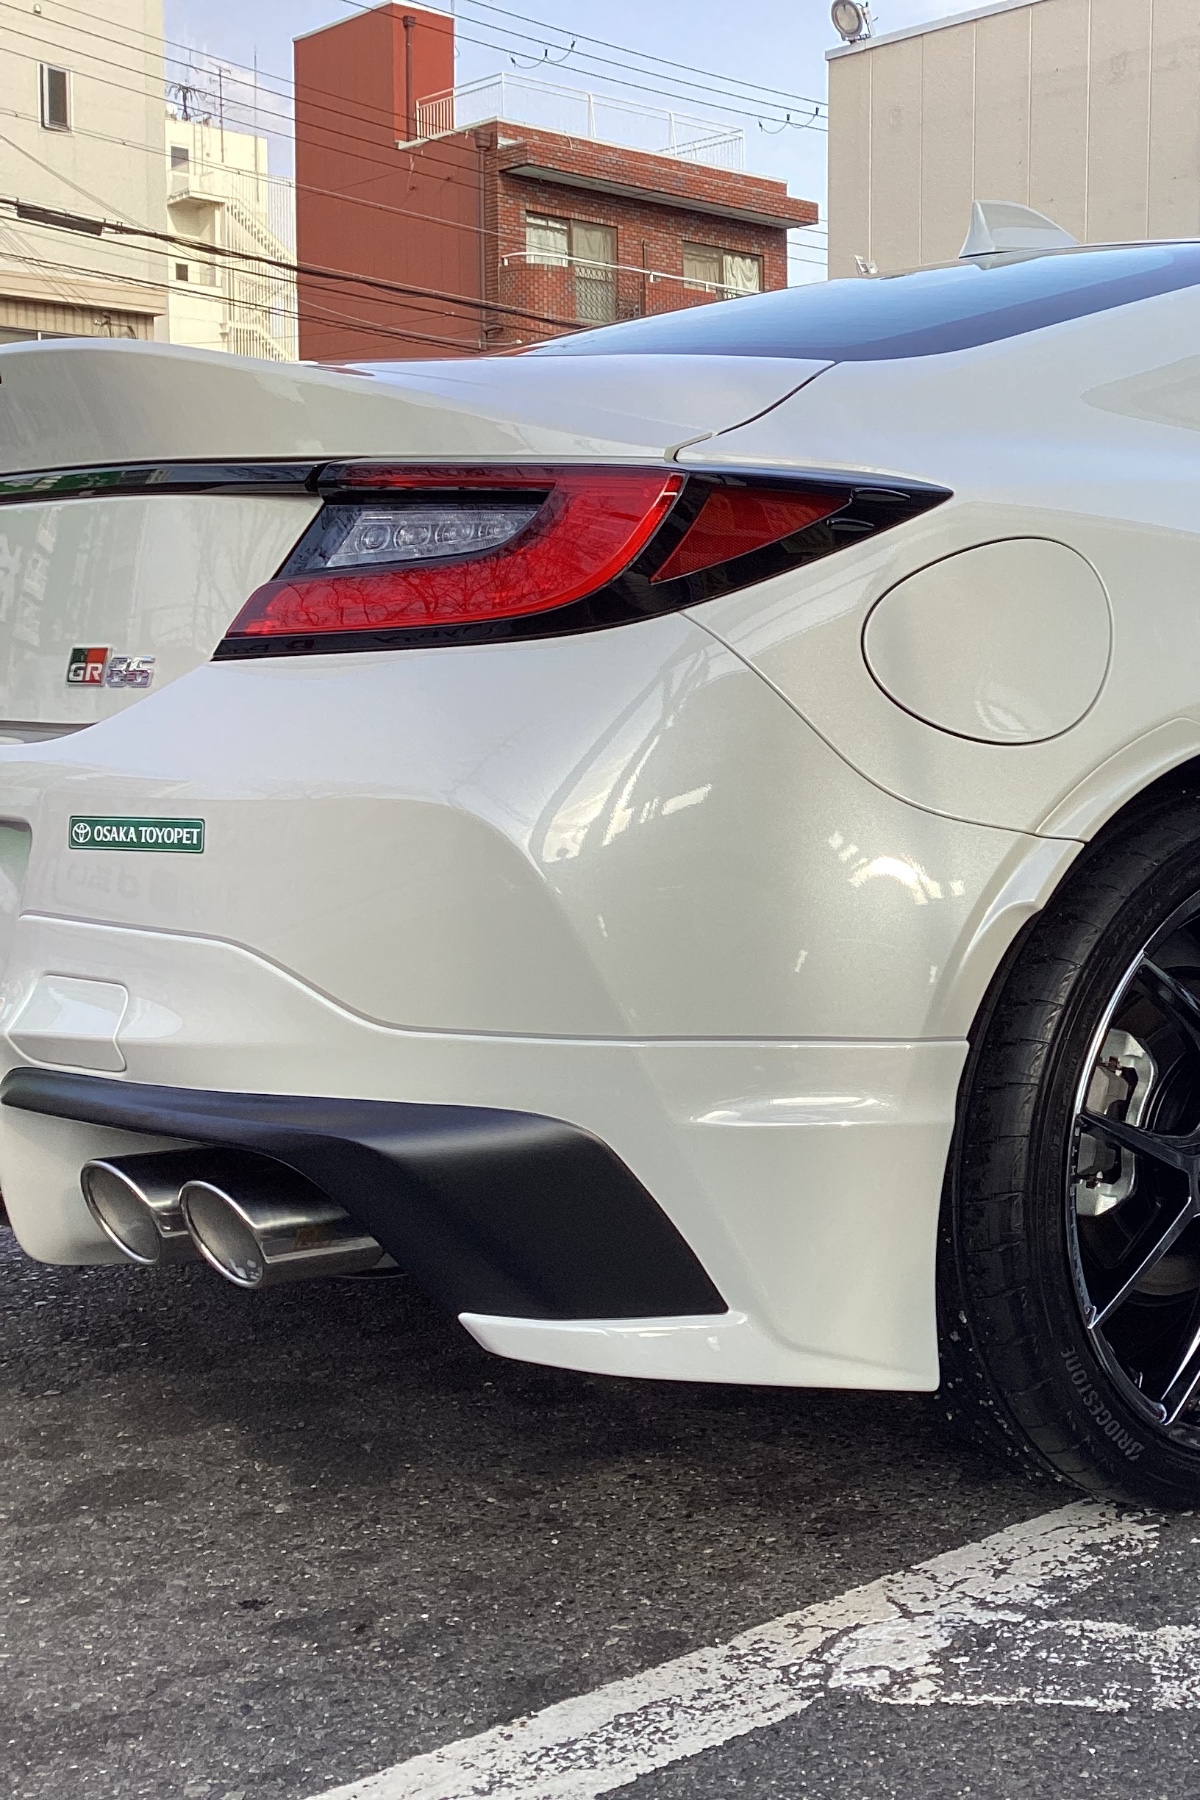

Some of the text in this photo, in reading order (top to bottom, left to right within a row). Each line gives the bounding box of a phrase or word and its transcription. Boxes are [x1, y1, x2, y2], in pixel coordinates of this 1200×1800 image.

[69, 663, 103, 682] GR
[94, 825, 201, 845] OSAKA TOYOPET
[1061, 1344, 1145, 1460] BRIDGESTONE
